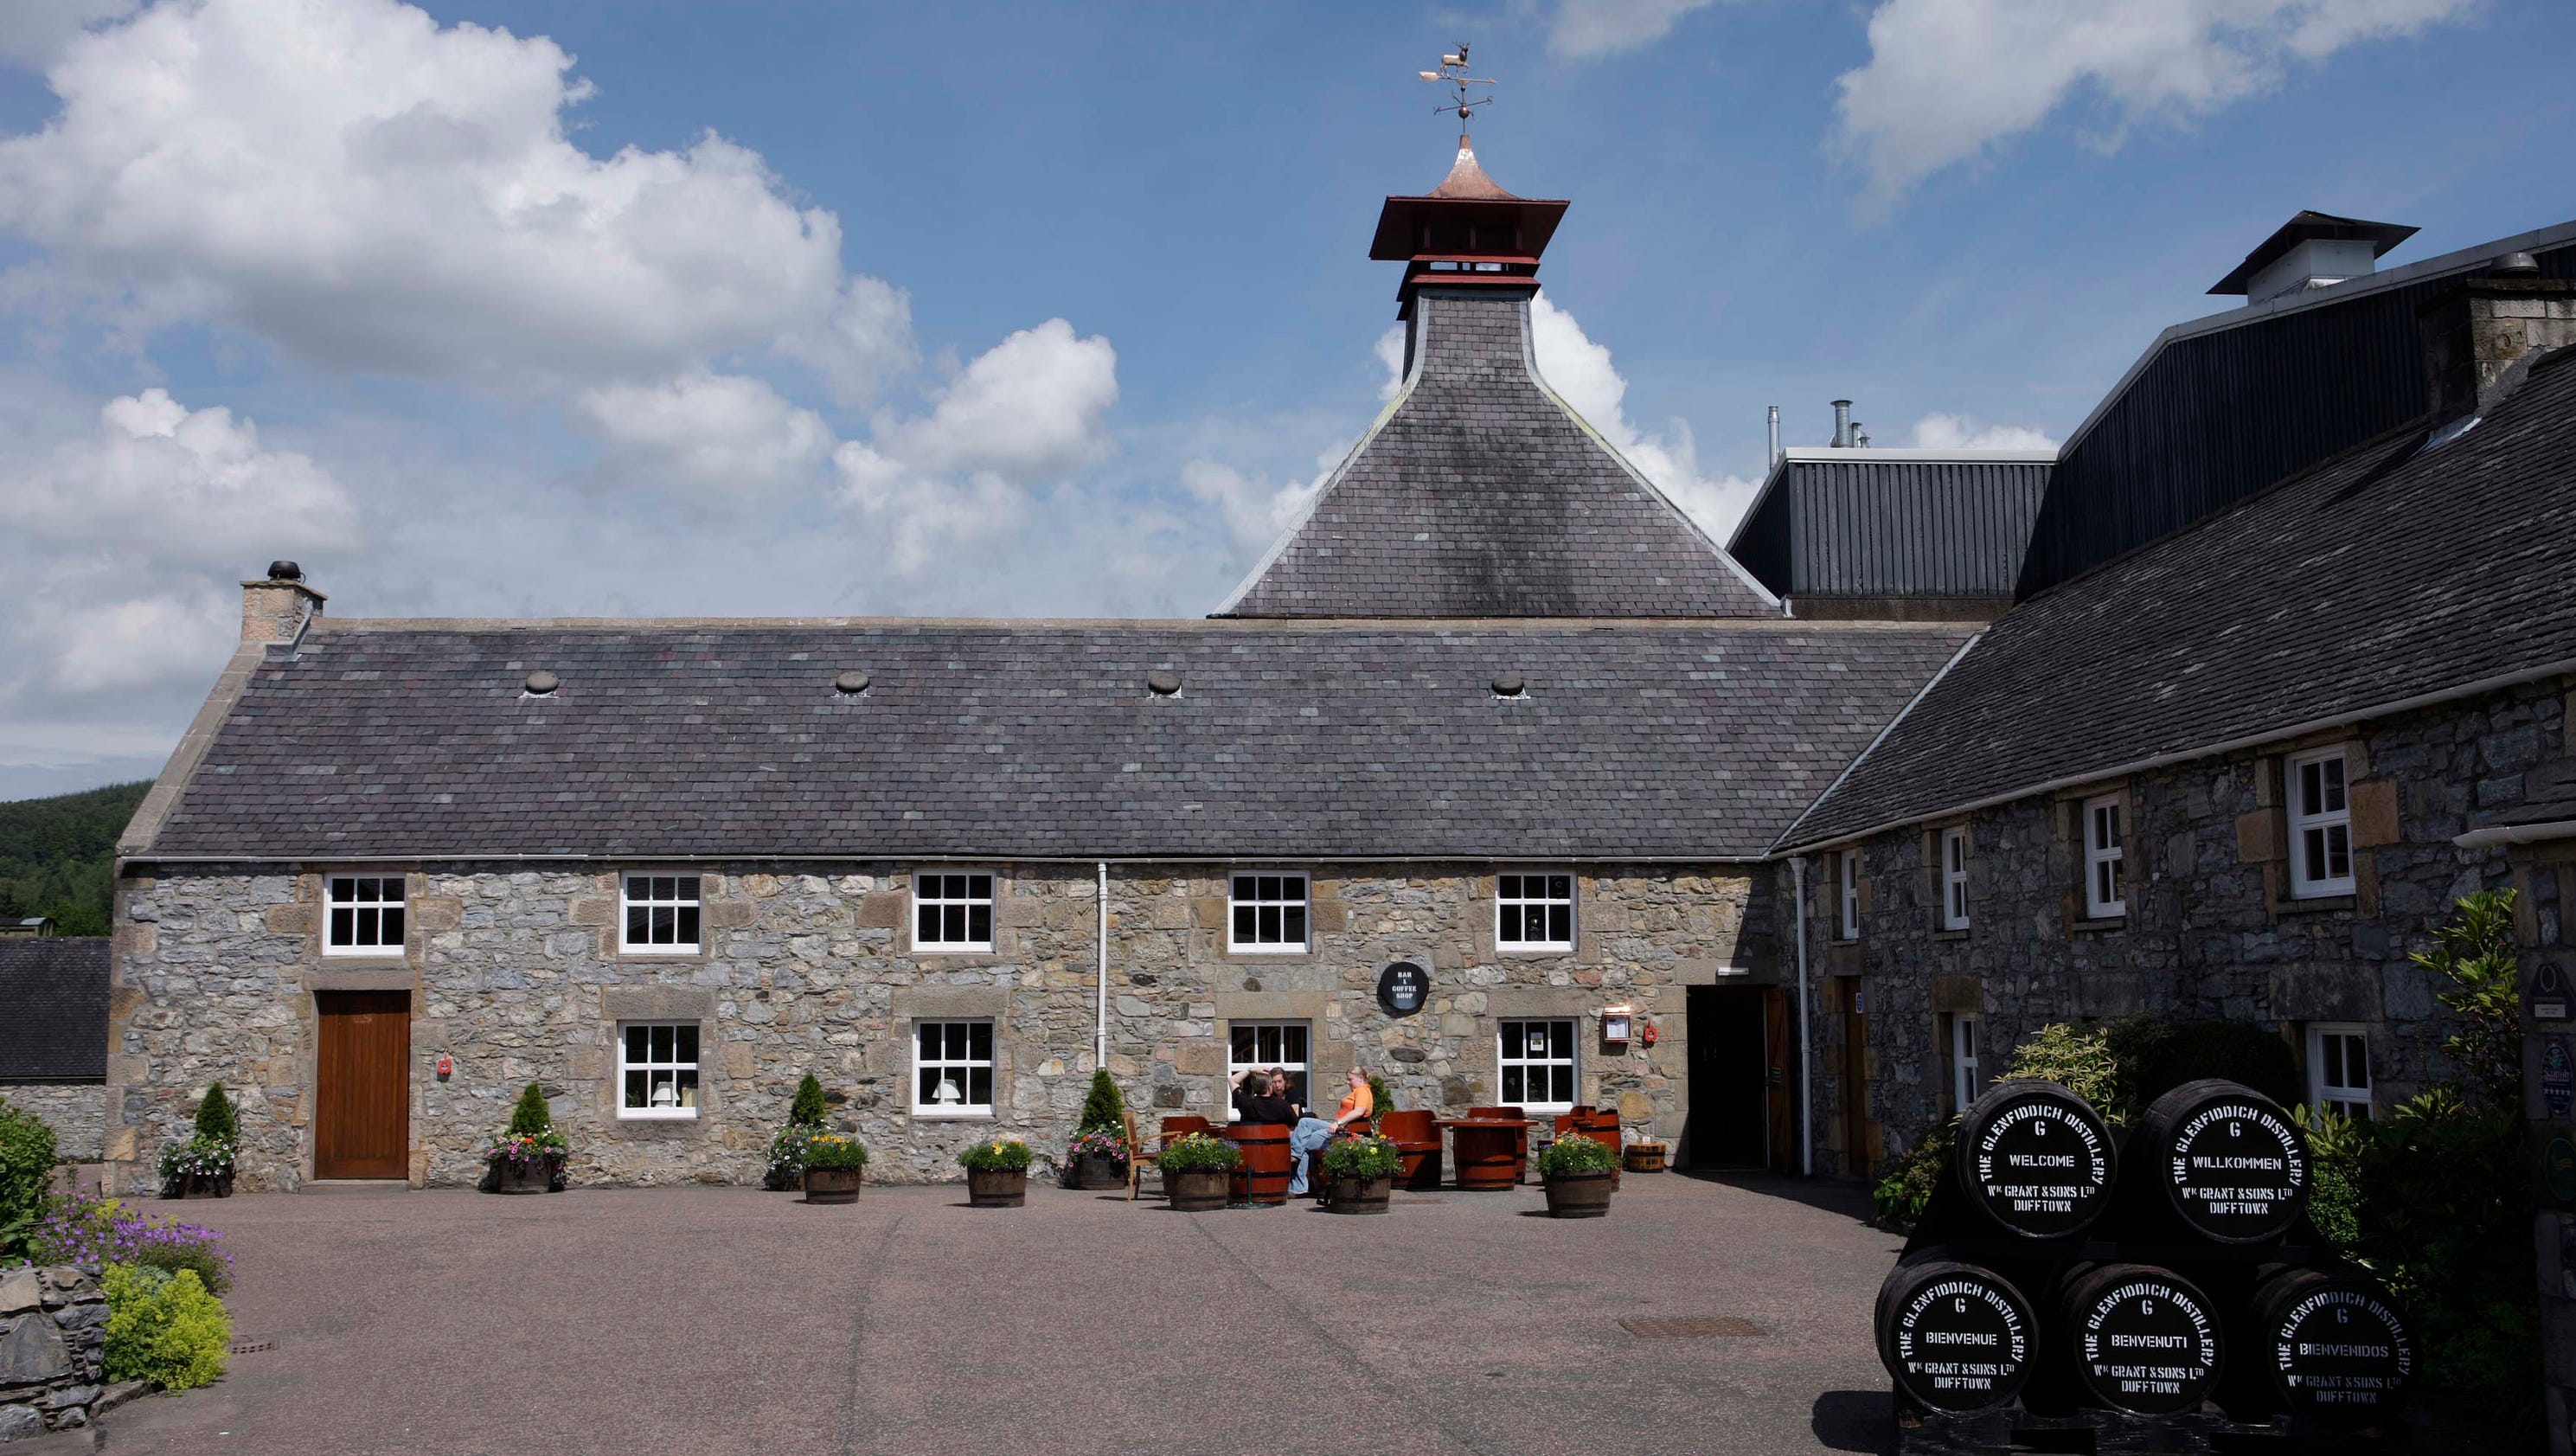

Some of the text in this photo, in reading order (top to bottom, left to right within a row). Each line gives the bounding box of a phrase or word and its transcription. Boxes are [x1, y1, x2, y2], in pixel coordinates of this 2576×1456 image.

[2035, 1121, 2046, 1136] G
[2230, 1122, 2240, 1137] G
[1979, 1105, 2105, 1184] THE GLENFIDDICH DISTILLERY
[2173, 1106, 2302, 1186] THE GLENFIDDICH DISTILLERY
[2009, 1154, 2074, 1167] WELCOME
[2193, 1157, 2281, 1170] WILLKOMMEN
[2004, 1185, 2039, 1197] GRANT
[2200, 1188, 2234, 1199] GRANT
[2015, 1200, 2071, 1212] DUFFTOWN
[2210, 1203, 2268, 1215] DUFFTOWN
[1955, 1298, 1965, 1312] G
[2142, 1300, 2152, 1315] G
[1900, 1282, 2024, 1362] THE GLENFIDDICH DISTILLERY
[2337, 1309, 2348, 1324] G
[2085, 1283, 2214, 1367] THE GLENFIDDICH DISTILLERY
[1926, 1332, 1997, 1345] BIENVENUE
[2278, 1291, 2411, 1376] THE GLENFIDDICH DISTILLERY
[2111, 1335, 2187, 1348] BENVENUTI
[2299, 1344, 2388, 1357] BIENVENIDOS
[1925, 1363, 1958, 1374] GRANT
[2111, 1365, 2146, 1378] GRANT
[1935, 1377, 1990, 1389] DUFFTOWN
[2122, 1381, 2180, 1394] DUFFTOWN
[2306, 1376, 2342, 1388] GRANT
[2316, 1391, 2377, 1403] DUFFTOWN
